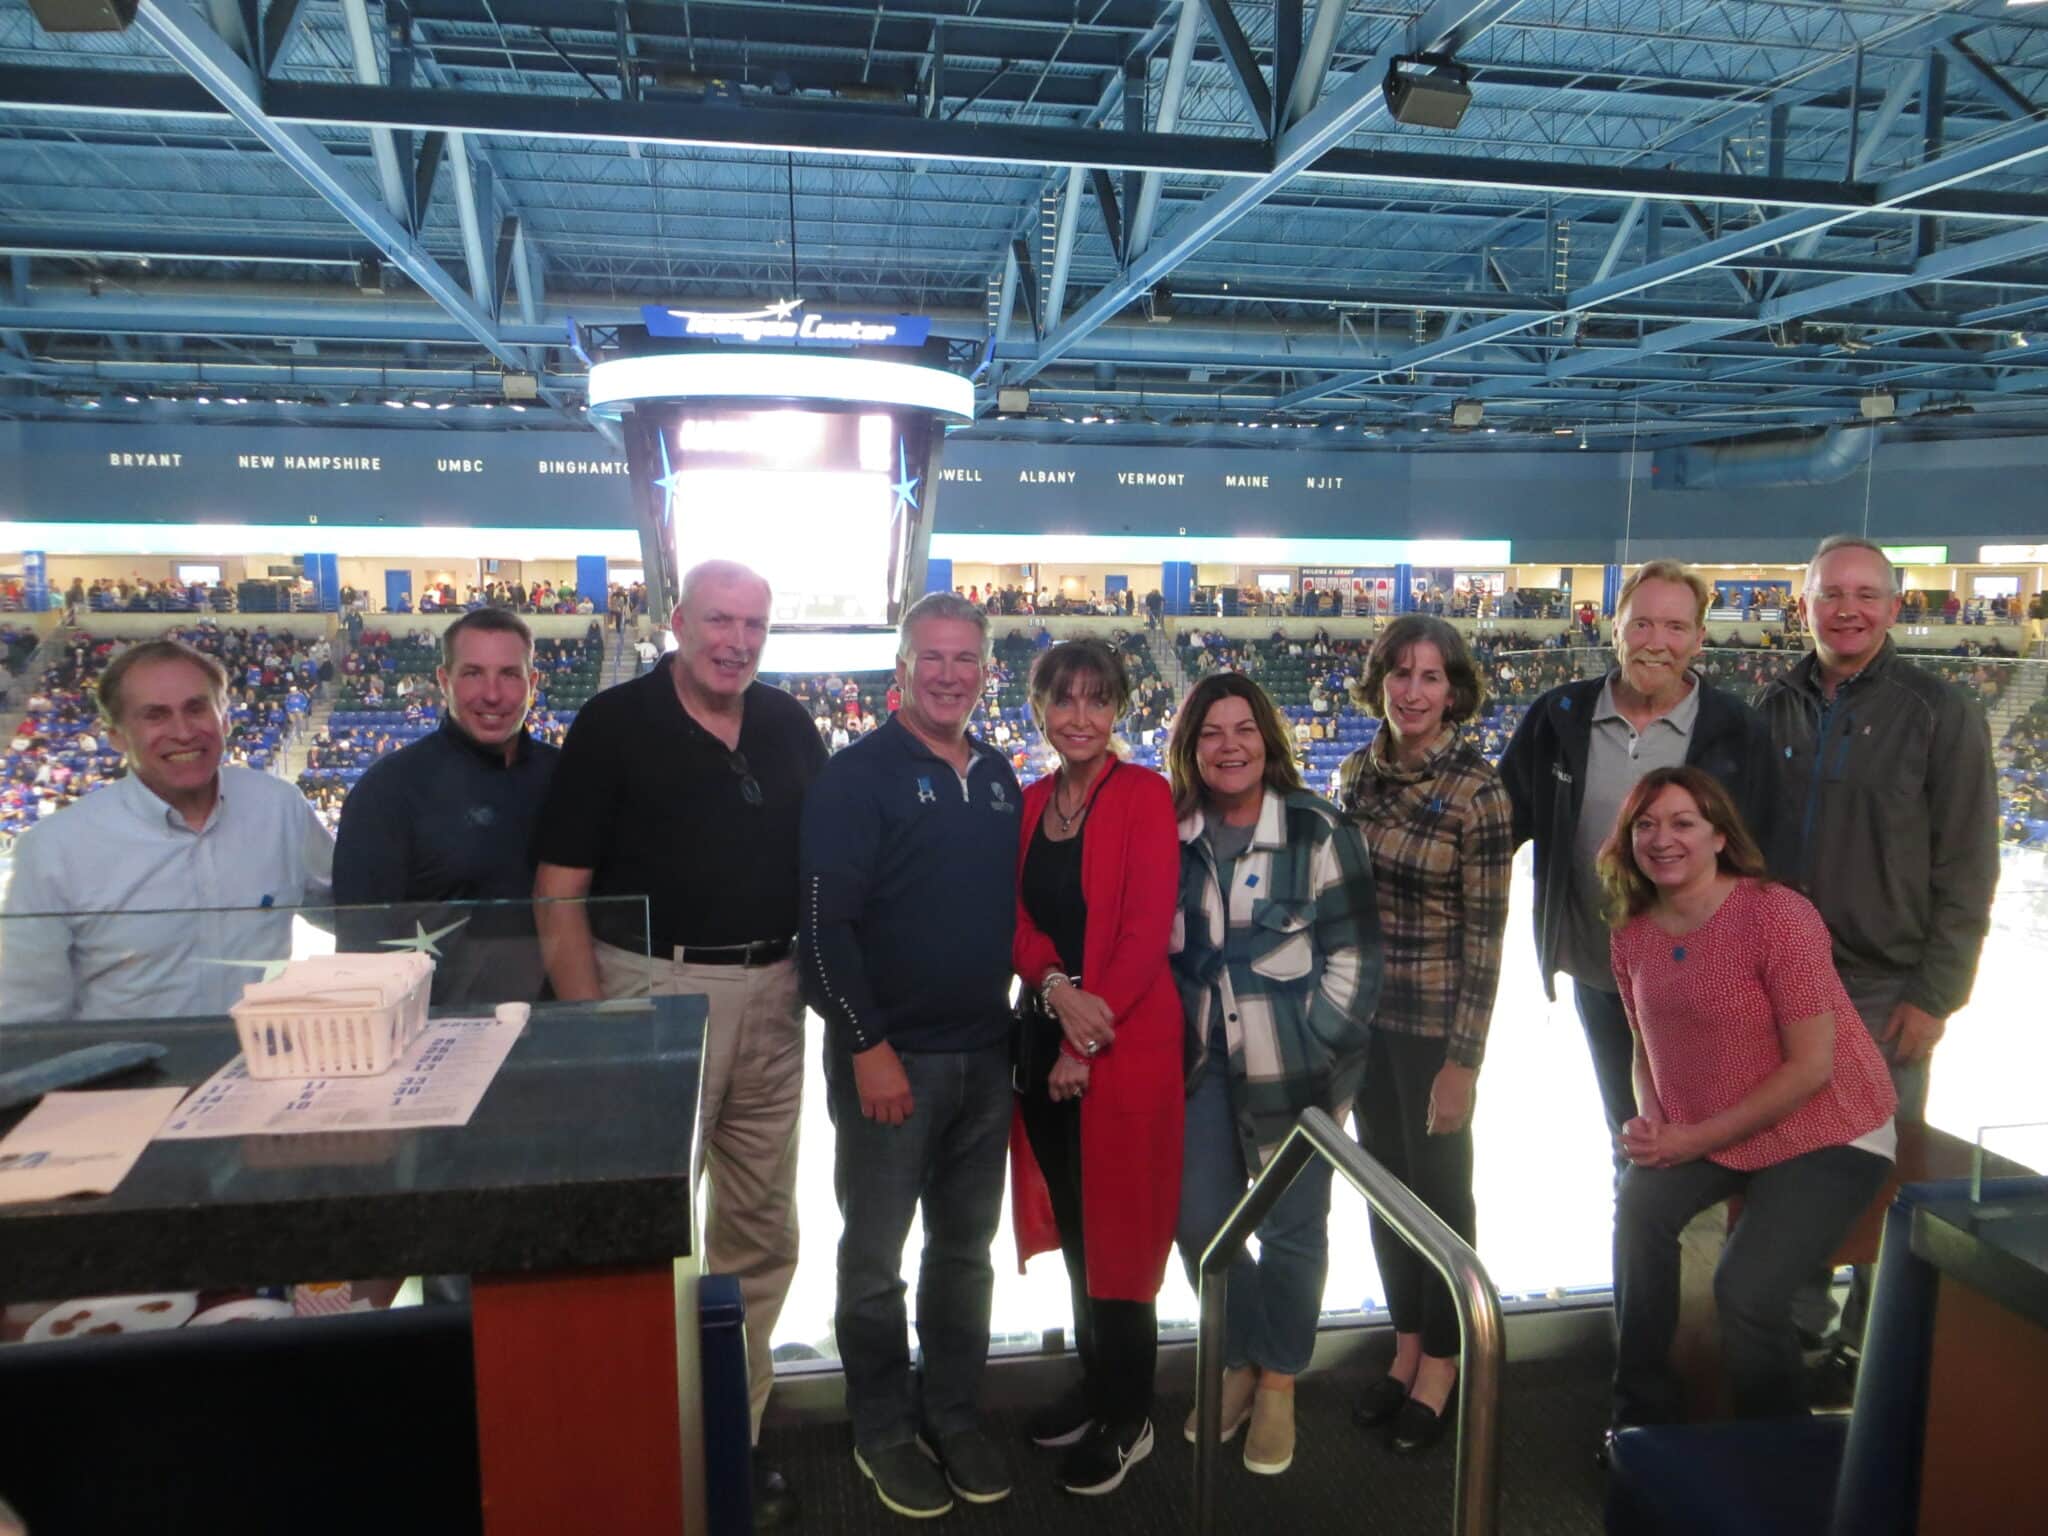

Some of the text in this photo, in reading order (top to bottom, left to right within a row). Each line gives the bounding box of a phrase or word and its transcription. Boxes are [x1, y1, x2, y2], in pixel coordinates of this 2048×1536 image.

[109, 452, 182, 467] BRYANT
[238, 455, 381, 470] NEW HAMPSHIRE
[437, 459, 484, 473] UMBC
[1019, 471, 1076, 484] ALBANY
[1117, 472, 1185, 485] VERMONT
[1225, 475, 1270, 488] MAINE
[1306, 477, 1344, 489] NJIT
